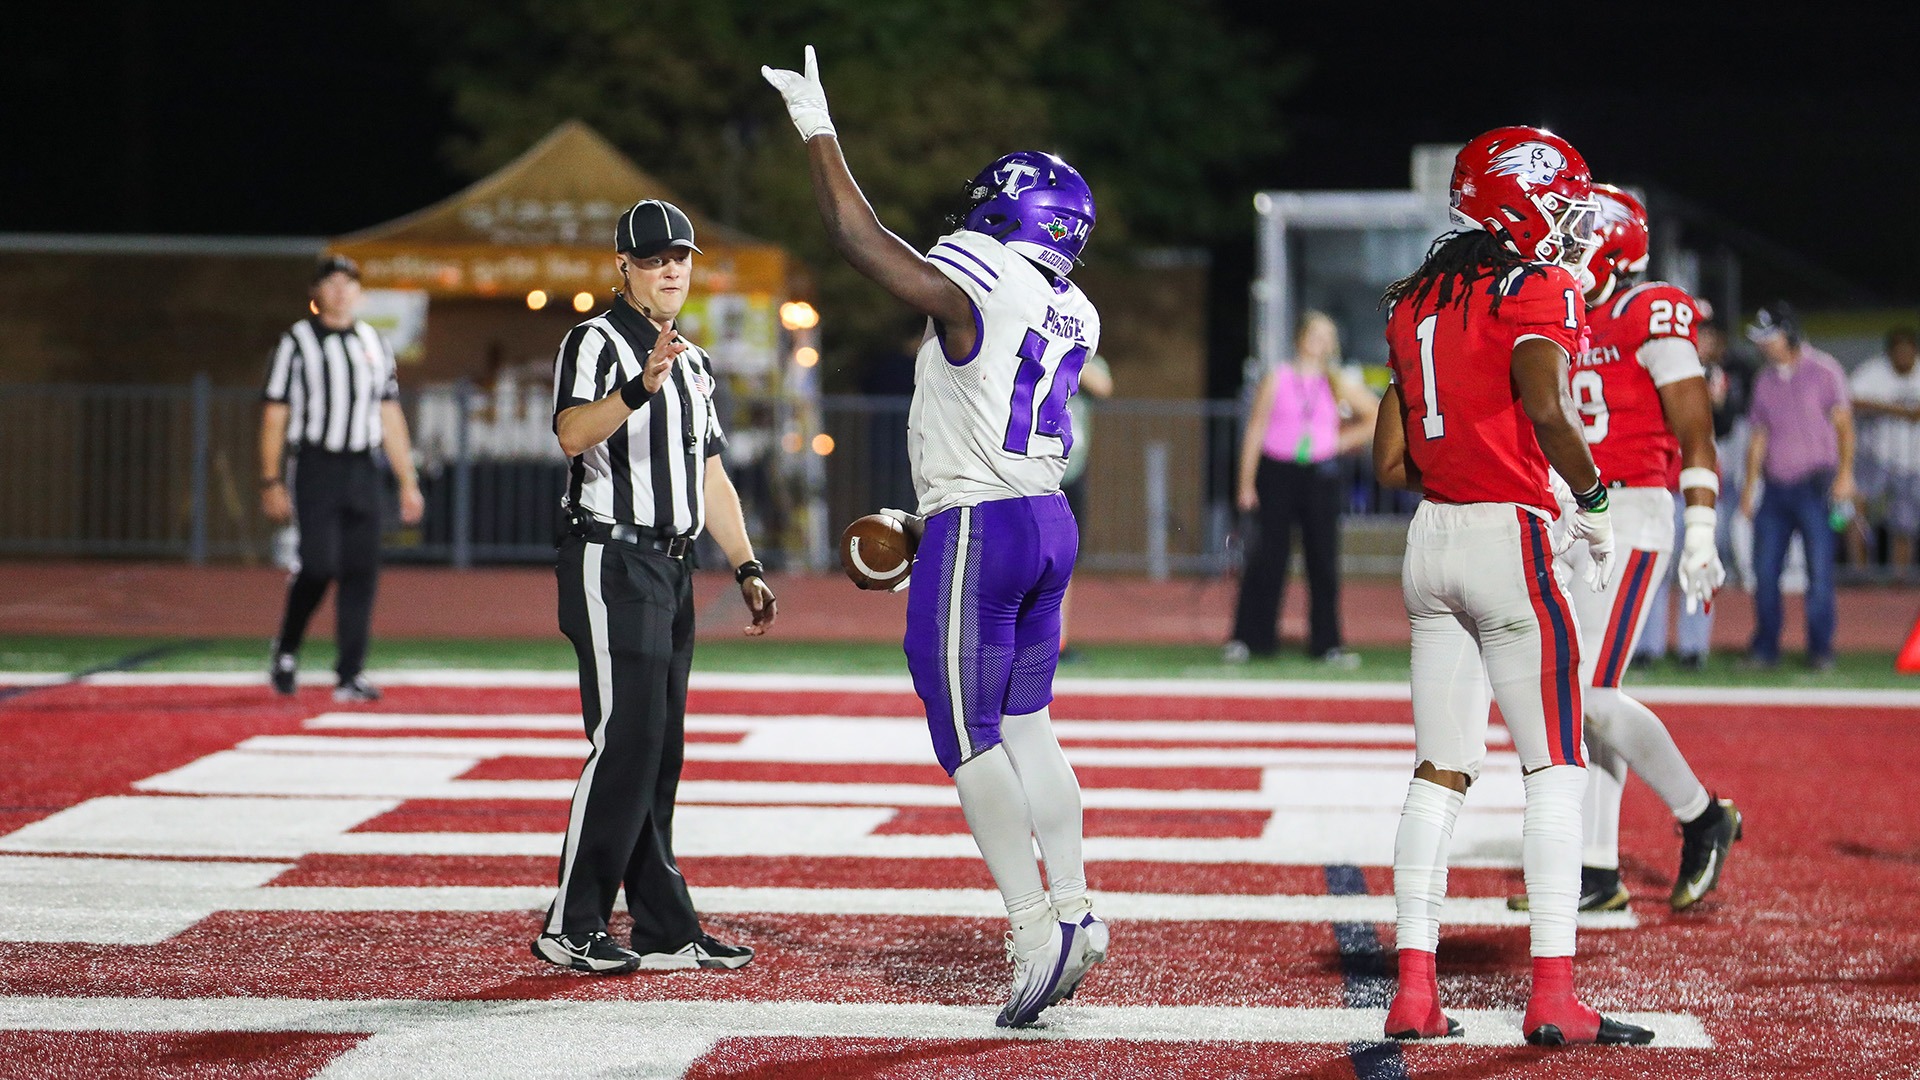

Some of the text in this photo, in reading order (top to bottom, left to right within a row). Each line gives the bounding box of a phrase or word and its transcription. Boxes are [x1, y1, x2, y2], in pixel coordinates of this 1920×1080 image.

[1074, 219, 1089, 240] 14
[1038, 250, 1061, 267] BLEED
[1563, 289, 1578, 329] 1
[1649, 299, 1693, 337] 29
[1002, 327, 1089, 459] 14
[1416, 313, 1445, 441] 1
[1571, 369, 1610, 445] 9
